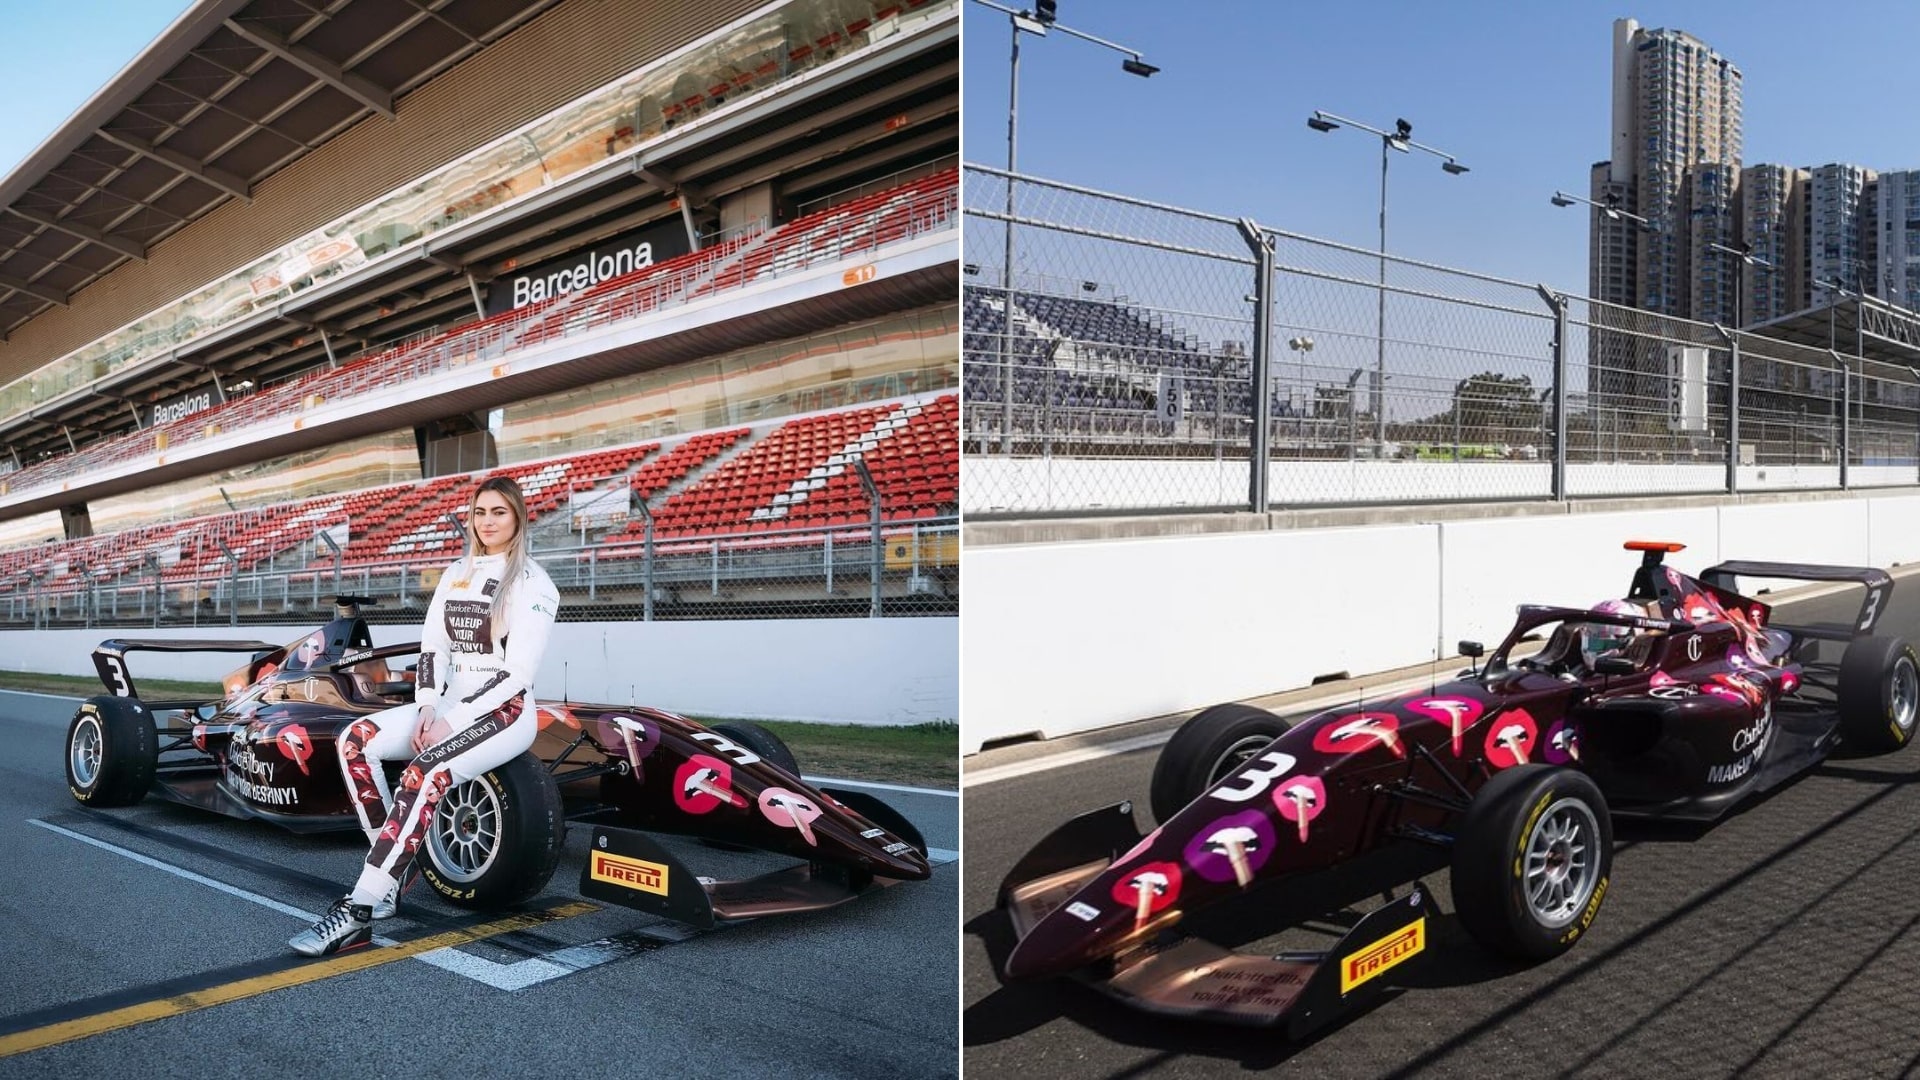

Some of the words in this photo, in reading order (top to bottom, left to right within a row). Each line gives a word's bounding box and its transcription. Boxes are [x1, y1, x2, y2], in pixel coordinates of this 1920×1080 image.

[513, 242, 654, 309] Barcelona
[855, 266, 874, 282] 11
[154, 393, 210, 427] Barcelona
[449, 617, 483, 629] MAKEUP
[1860, 589, 1881, 630] 3
[453, 630, 474, 641] YOUR
[107, 657, 130, 697] 3
[690, 732, 760, 765] 3
[1209, 752, 1296, 802] 3
[426, 870, 462, 899] ZERO
[597, 856, 661, 888] PIRELLI
[465, 888, 475, 899] P
[1350, 928, 1417, 982] PIRELLI
